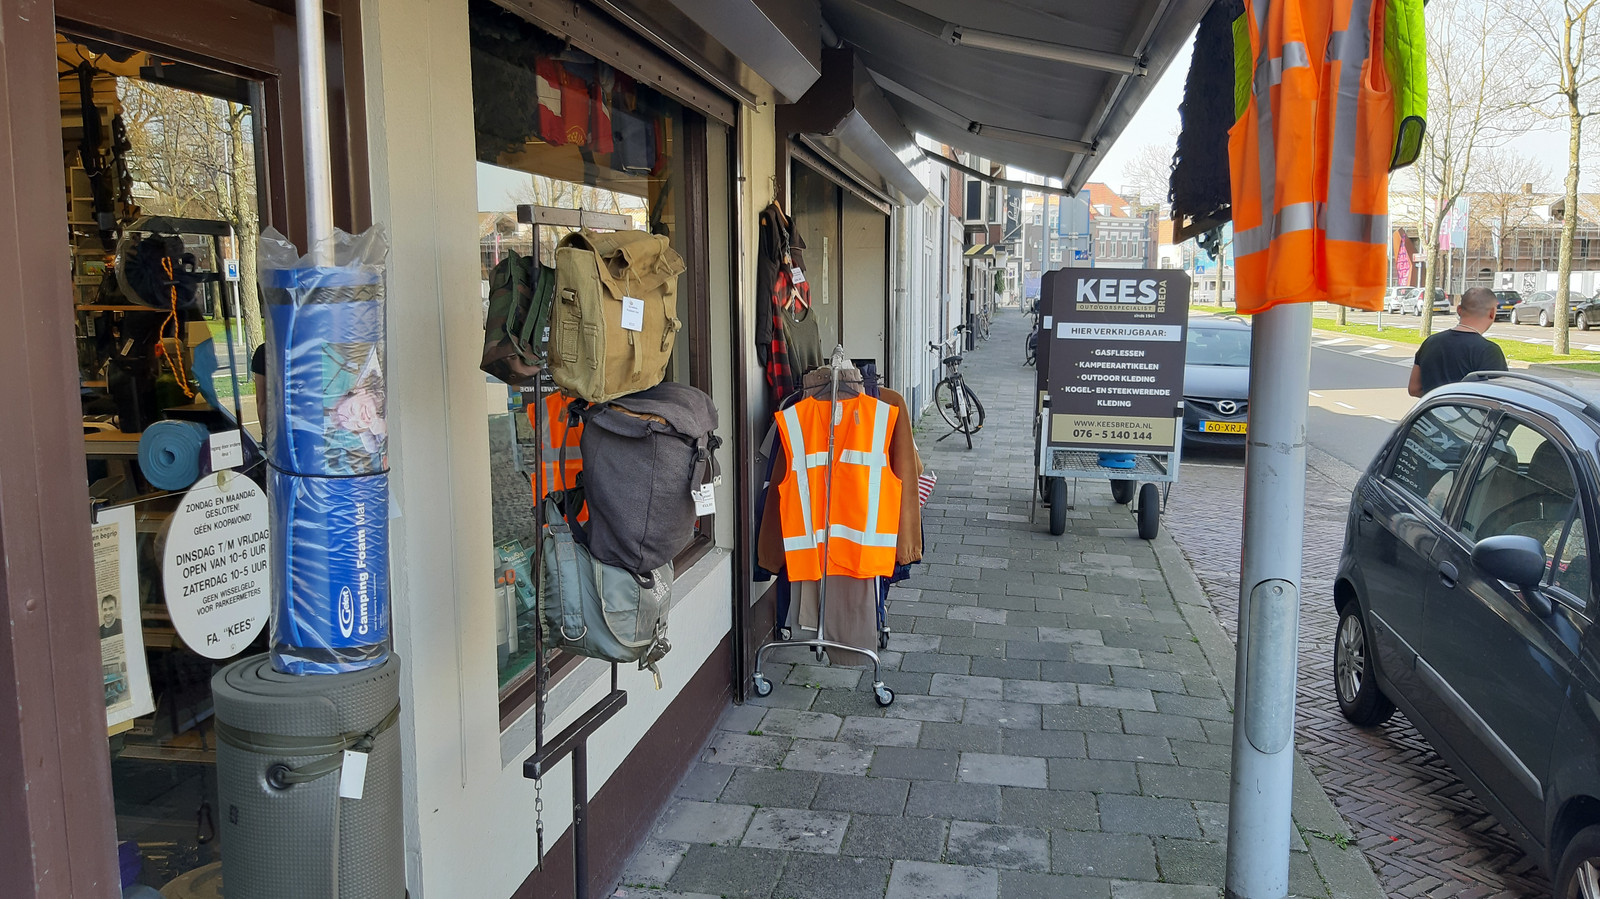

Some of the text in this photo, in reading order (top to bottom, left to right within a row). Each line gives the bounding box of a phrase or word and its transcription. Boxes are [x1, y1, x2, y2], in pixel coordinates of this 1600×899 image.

[1076, 278, 1157, 304] KEES
[1157, 280, 1167, 313] BREDA
[1071, 327, 1167, 337] HIER VERKRIJGBAAR:
[1095, 349, 1145, 357] GASFLESSEN
[1079, 361, 1159, 370] KAMPEERARTIKELEN
[1080, 374, 1156, 383] OUTDOOR KLEDING
[1107, 387, 1170, 396] STEEKWERENDE
[1073, 420, 1152, 429] WWW.KEESBREDA.NL
[1208, 423, 1247, 432] 60-XRJ-
[1073, 429, 1093, 438] 076
[1133, 431, 1152, 440] 144
[186, 489, 256, 513] ZONDAG EN MAANDAG
[205, 503, 240, 519] GESLOTEN!
[214, 513, 252, 530] KOOPAVOND!
[176, 529, 270, 566] DINSDAG T/M VRIJDAG
[182, 544, 266, 578] OPEN VAN 10-6 UUR
[355, 502, 369, 635] Camping Foam Mat
[183, 560, 268, 597] ZATERDAG 10-5 UUR
[202, 580, 255, 604] GEEN WISSELGELD
[196, 588, 261, 616] VOOR PARKEERMETERS
[206, 632, 220, 646] FA.
